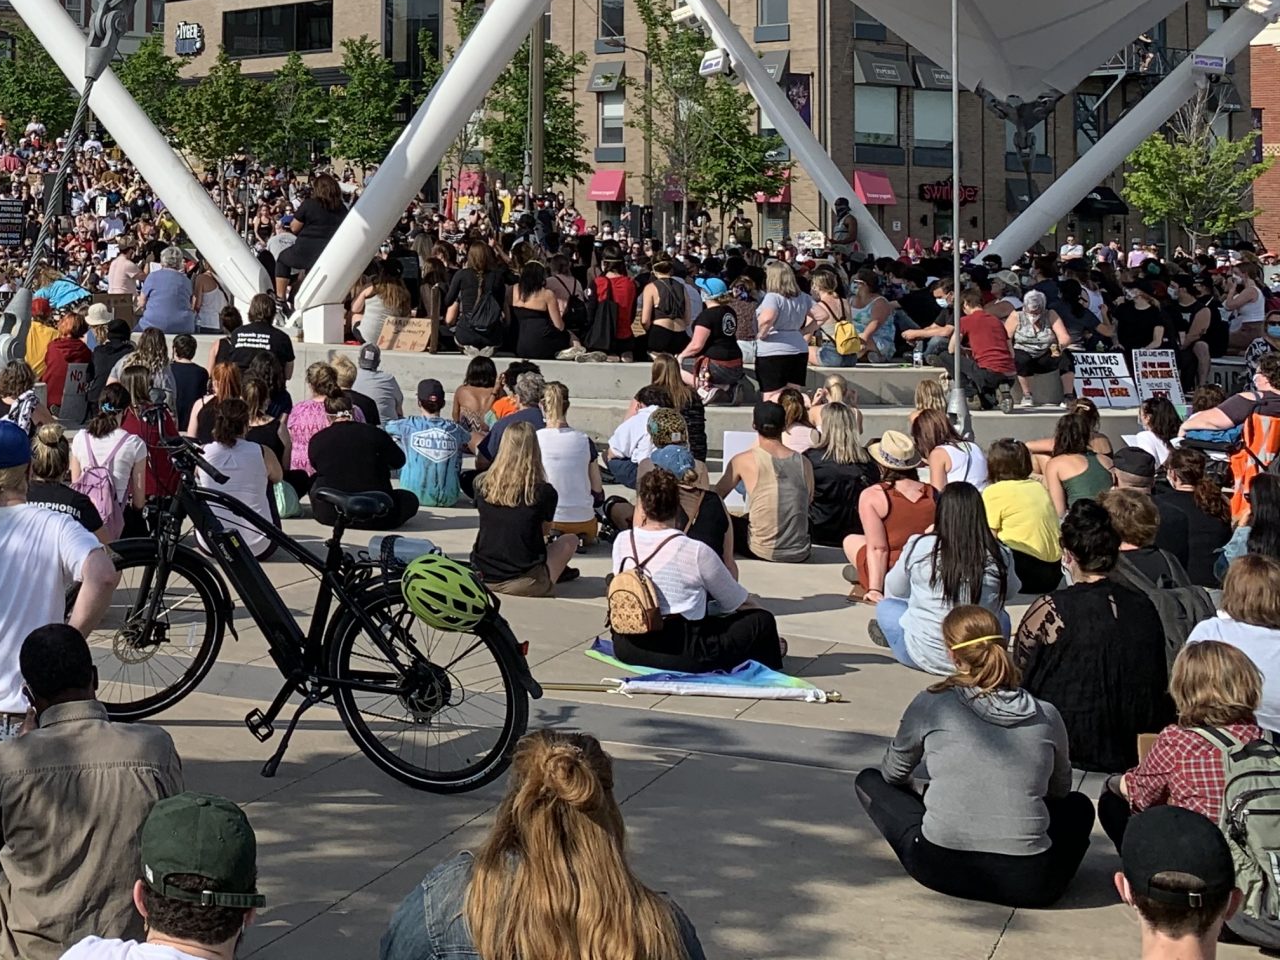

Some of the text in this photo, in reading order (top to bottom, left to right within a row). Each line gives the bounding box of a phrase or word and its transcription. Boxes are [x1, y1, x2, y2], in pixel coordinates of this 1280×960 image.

[1073, 354, 1119, 366] BLACK LIVES
[70, 368, 83, 382] NO
[1079, 366, 1115, 377] MATTER
[413, 436, 432, 448] ZOO
